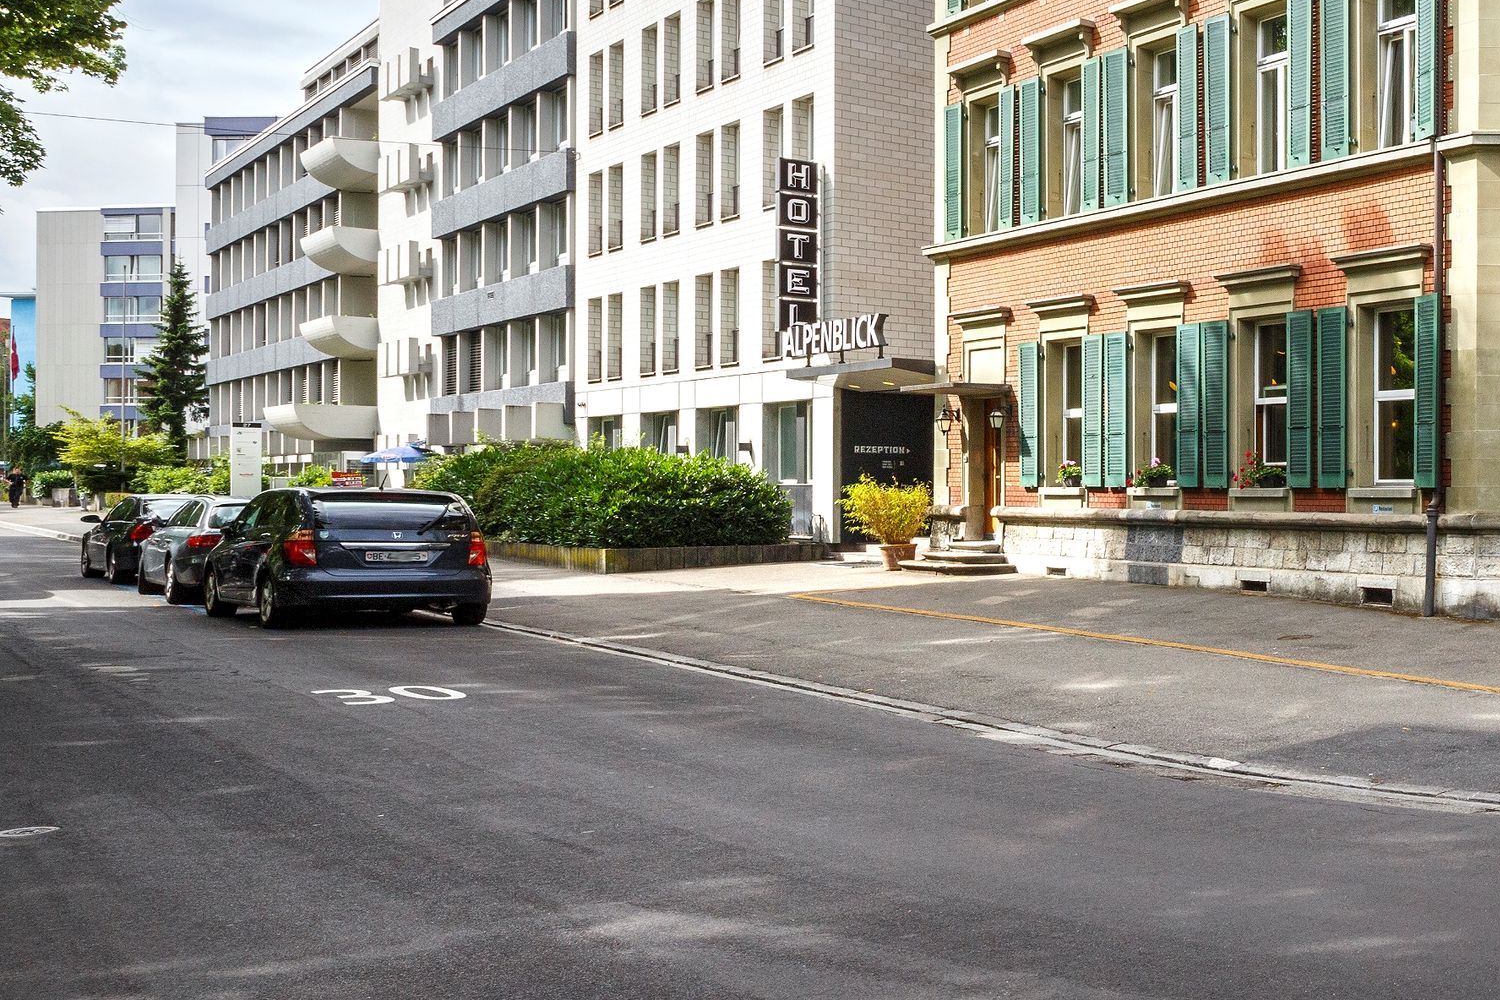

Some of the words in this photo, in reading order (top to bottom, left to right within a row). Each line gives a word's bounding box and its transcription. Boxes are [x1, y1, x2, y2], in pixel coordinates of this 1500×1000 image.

[786, 162, 811, 329] HOTEL
[782, 312, 882, 358] ALPENBLICK
[853, 445, 905, 454] REZEPTION
[310, 685, 467, 706] 30
